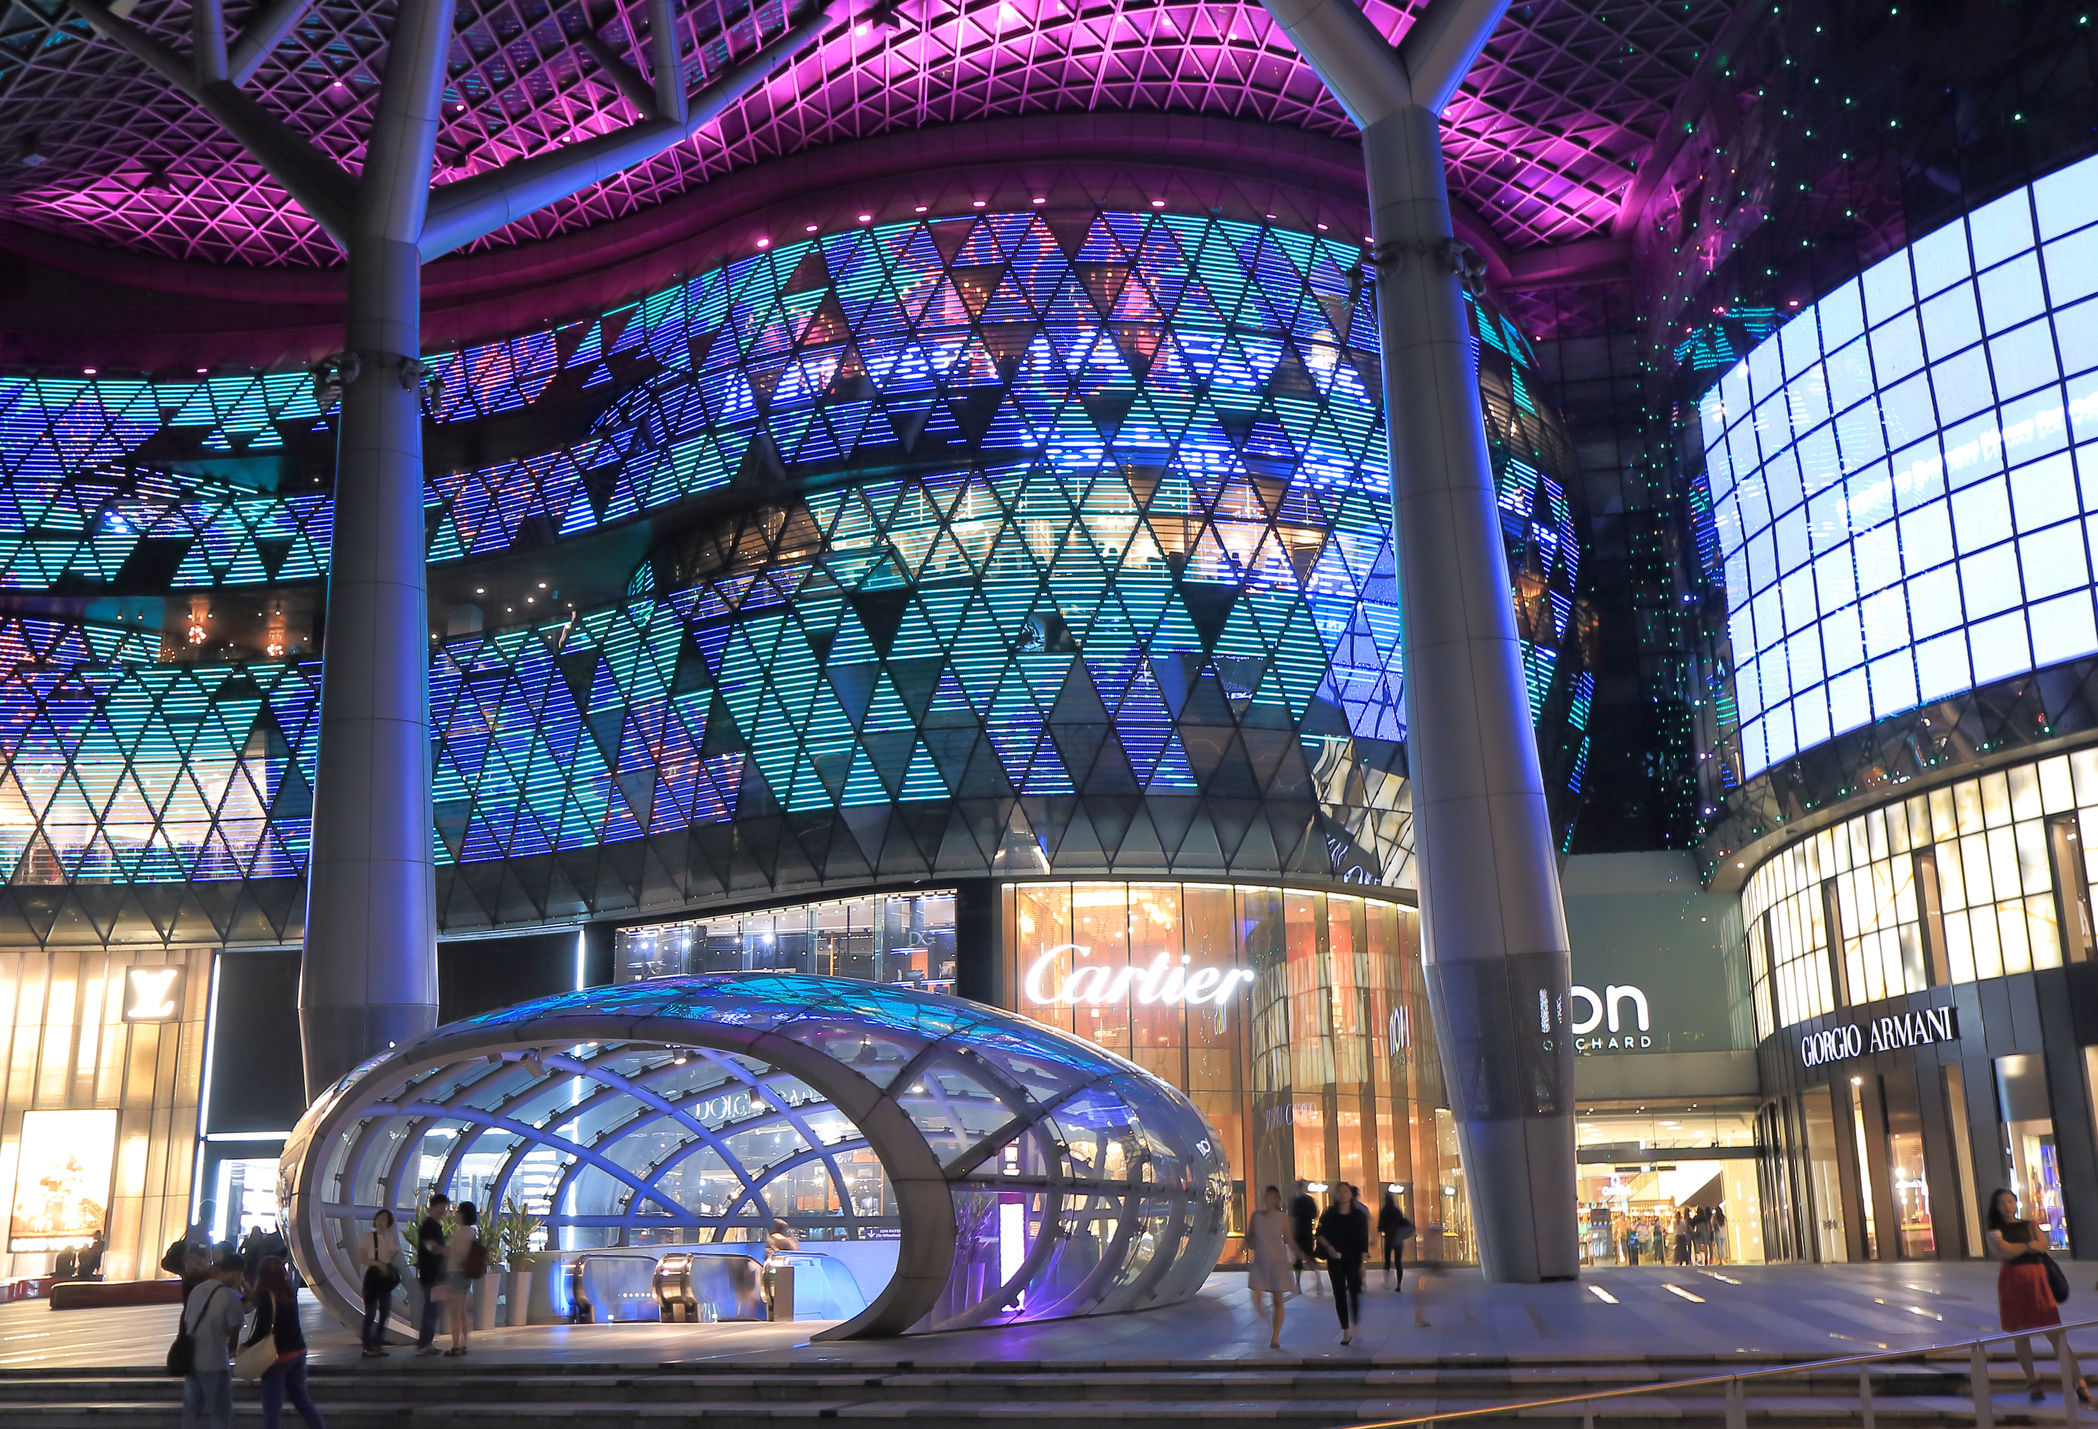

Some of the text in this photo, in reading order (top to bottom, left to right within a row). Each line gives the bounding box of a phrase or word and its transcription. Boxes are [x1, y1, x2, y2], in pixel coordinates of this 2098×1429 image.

[1025, 943, 1255, 1005] Cartier
[1542, 1035, 1652, 1052] OCHARD
[1801, 1005, 1953, 1068] GIORGIO ARMANI
